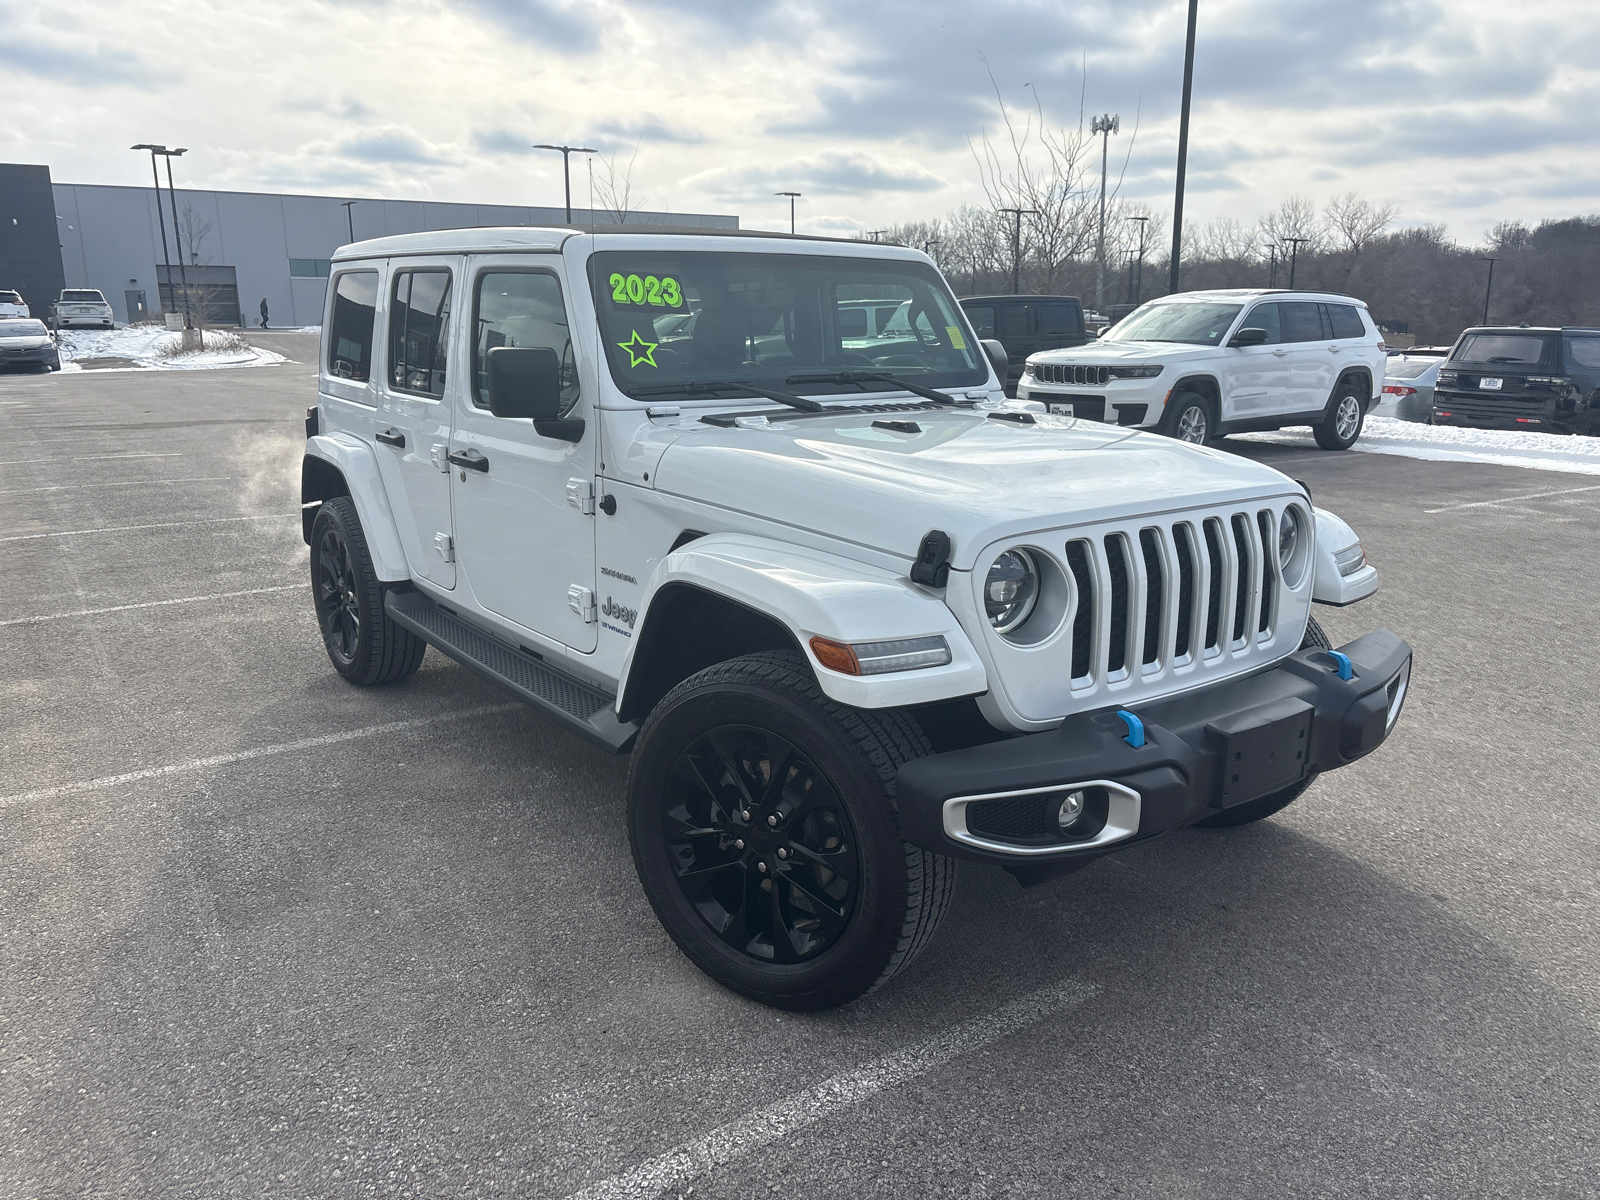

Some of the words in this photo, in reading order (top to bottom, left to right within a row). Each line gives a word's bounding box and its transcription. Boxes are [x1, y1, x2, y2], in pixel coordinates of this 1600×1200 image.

[609, 273, 683, 308] 2023
[602, 595, 638, 629] Jeep
[608, 623, 632, 638] WRANG
